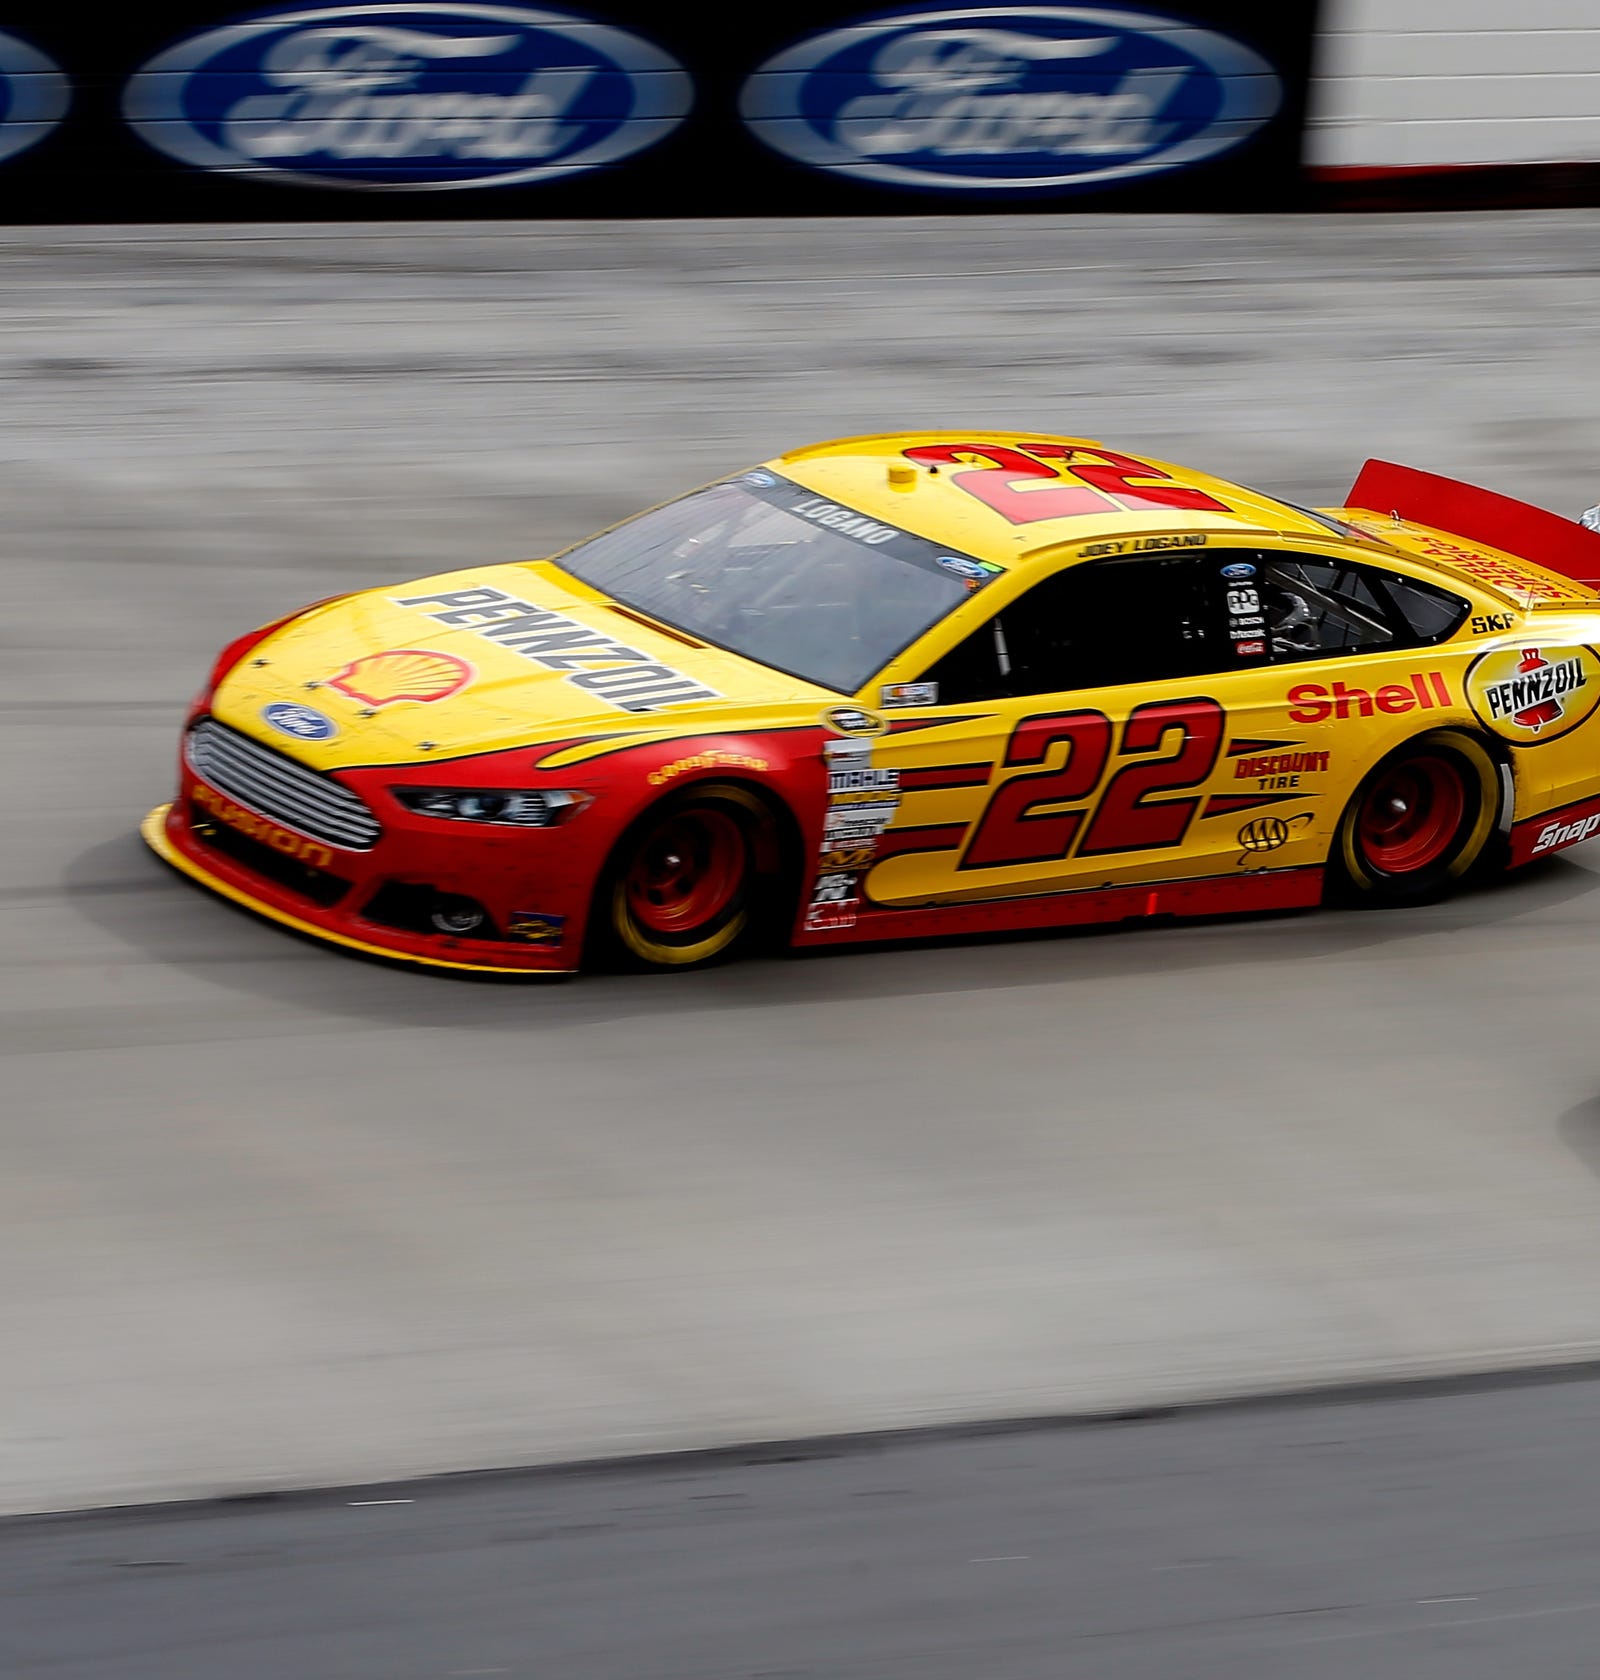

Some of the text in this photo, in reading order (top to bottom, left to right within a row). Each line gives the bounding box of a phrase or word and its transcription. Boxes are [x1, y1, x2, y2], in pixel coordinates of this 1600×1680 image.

[220, 26, 600, 160] Ford
[833, 28, 1193, 156] Ford
[902, 443, 1234, 524] 22
[790, 499, 900, 545] LOGANO
[1077, 534, 1208, 558] JOEY LOGANO
[388, 585, 724, 713] PENNZOIL
[1471, 613, 1515, 634] SKF
[1287, 672, 1453, 724] Shell
[1485, 657, 1587, 719] PENNZOIL
[956, 696, 1226, 871] 22
[1234, 750, 1330, 779] DISCOUNT
[1258, 775, 1300, 790] TIRE
